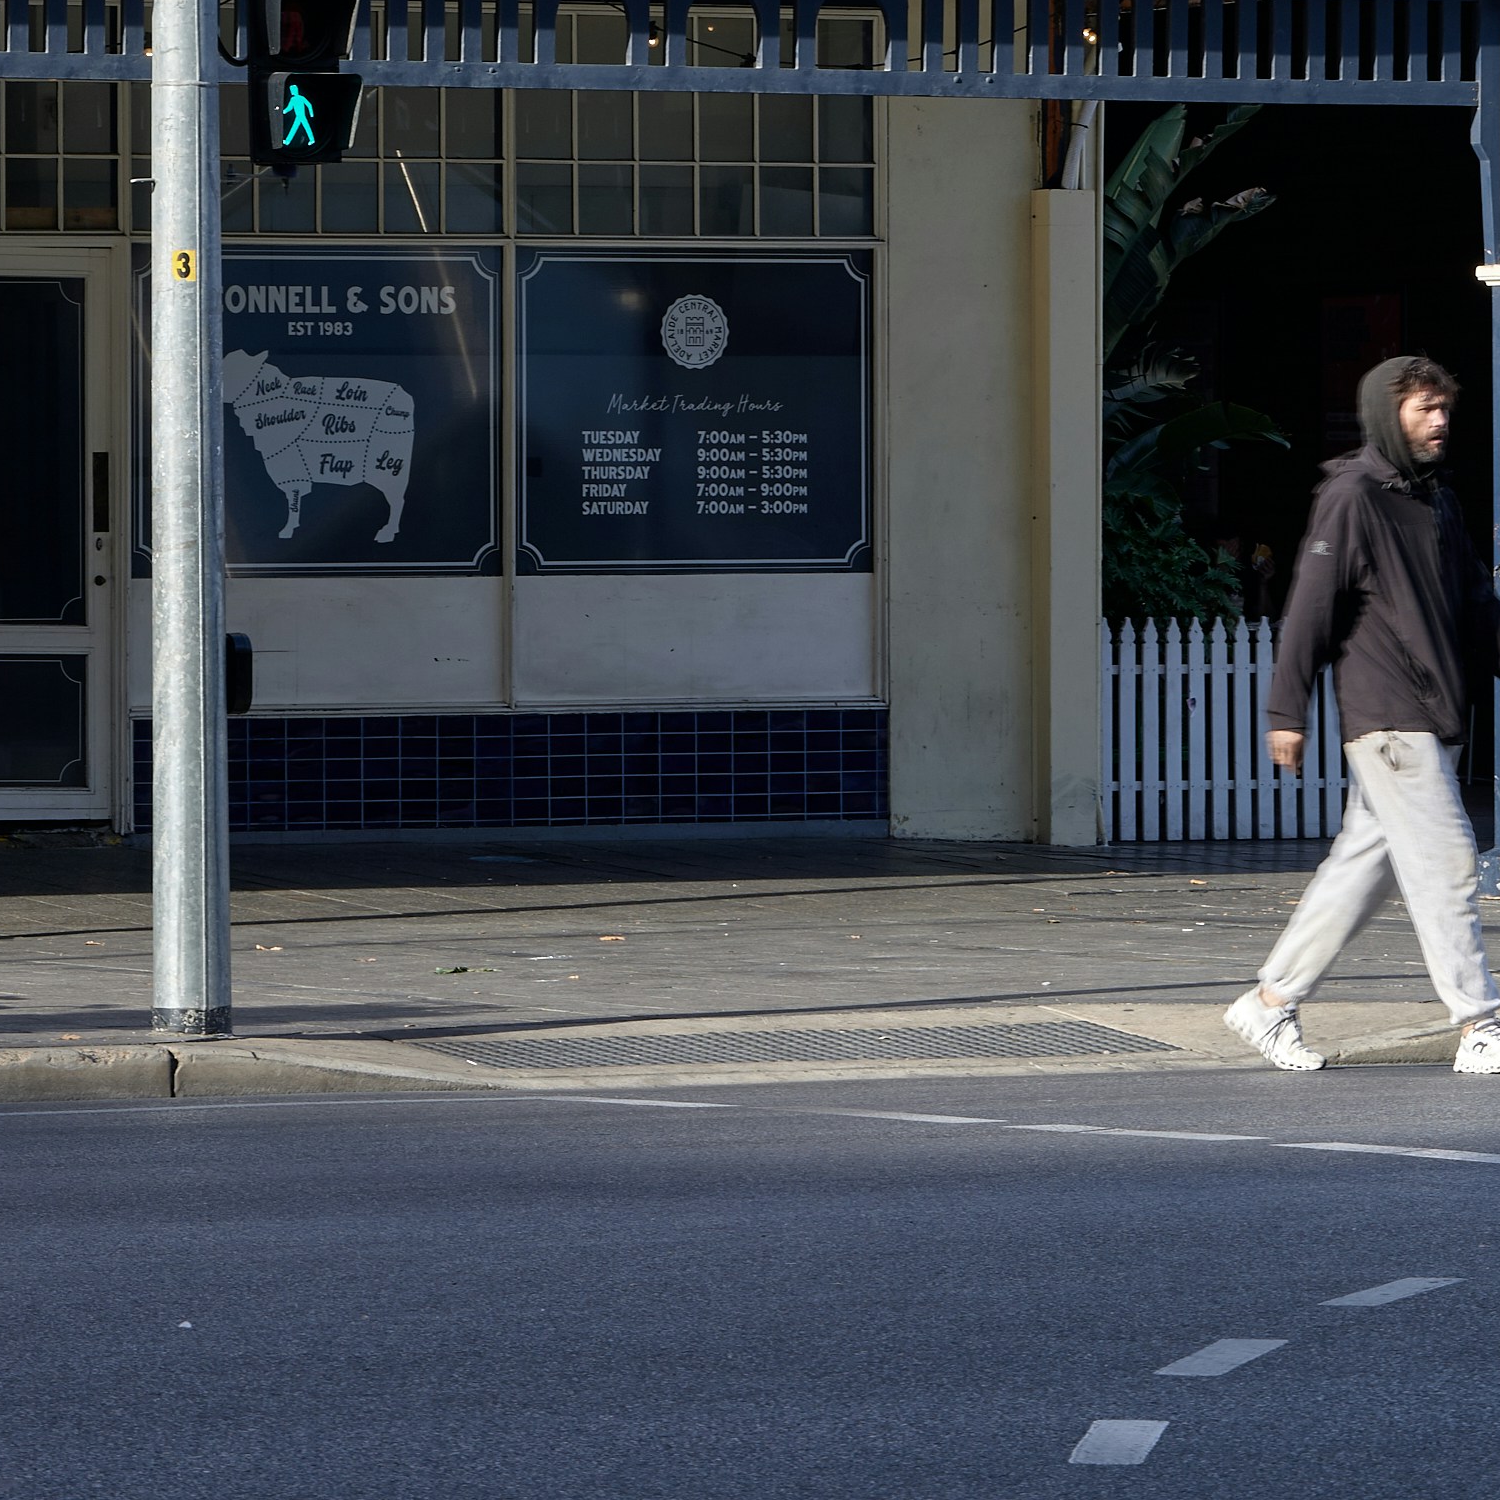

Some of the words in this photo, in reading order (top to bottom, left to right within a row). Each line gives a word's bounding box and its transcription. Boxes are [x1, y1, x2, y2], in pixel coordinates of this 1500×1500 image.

[176, 252, 191, 279] 3
[224, 285, 337, 314] ONNELL
[346, 286, 369, 313] &
[379, 285, 456, 315] SONS
[679, 302, 718, 323] CENTRAL
[288, 322, 314, 336] EST
[319, 322, 353, 336] 1983
[668, 315, 692, 360] ADELAIDE
[698, 326, 722, 361] MARKET
[255, 377, 282, 396] Neck
[293, 382, 316, 396] Rack
[335, 382, 368, 402] Loin
[607, 393, 670, 414] Market
[672, 395, 734, 417] Trading
[737, 394, 783, 413] Hours
[254, 409, 307, 429] Shoulder
[322, 414, 356, 435] Ribs
[582, 431, 640, 444] TUESDAY
[697, 431, 745, 444] 7:00AM
[761, 431, 808, 444] 5:30PM
[376, 450, 403, 476] Leg
[582, 448, 661, 462] WEDNESDAY
[697, 448, 745, 462] 9:00AM
[761, 448, 808, 462] 5:30PM
[320, 453, 355, 478] Flap
[582, 466, 650, 479] THURSDAY
[697, 466, 745, 479] 9:00AM
[761, 466, 808, 479] 5:30PM
[582, 484, 627, 497] FRIDAY
[696, 484, 745, 497] 7:00AM
[760, 484, 808, 497] 9:00PM
[582, 501, 649, 515] SATURDAY
[696, 501, 745, 515] 7:00AM
[760, 501, 808, 515] 3:00PM
